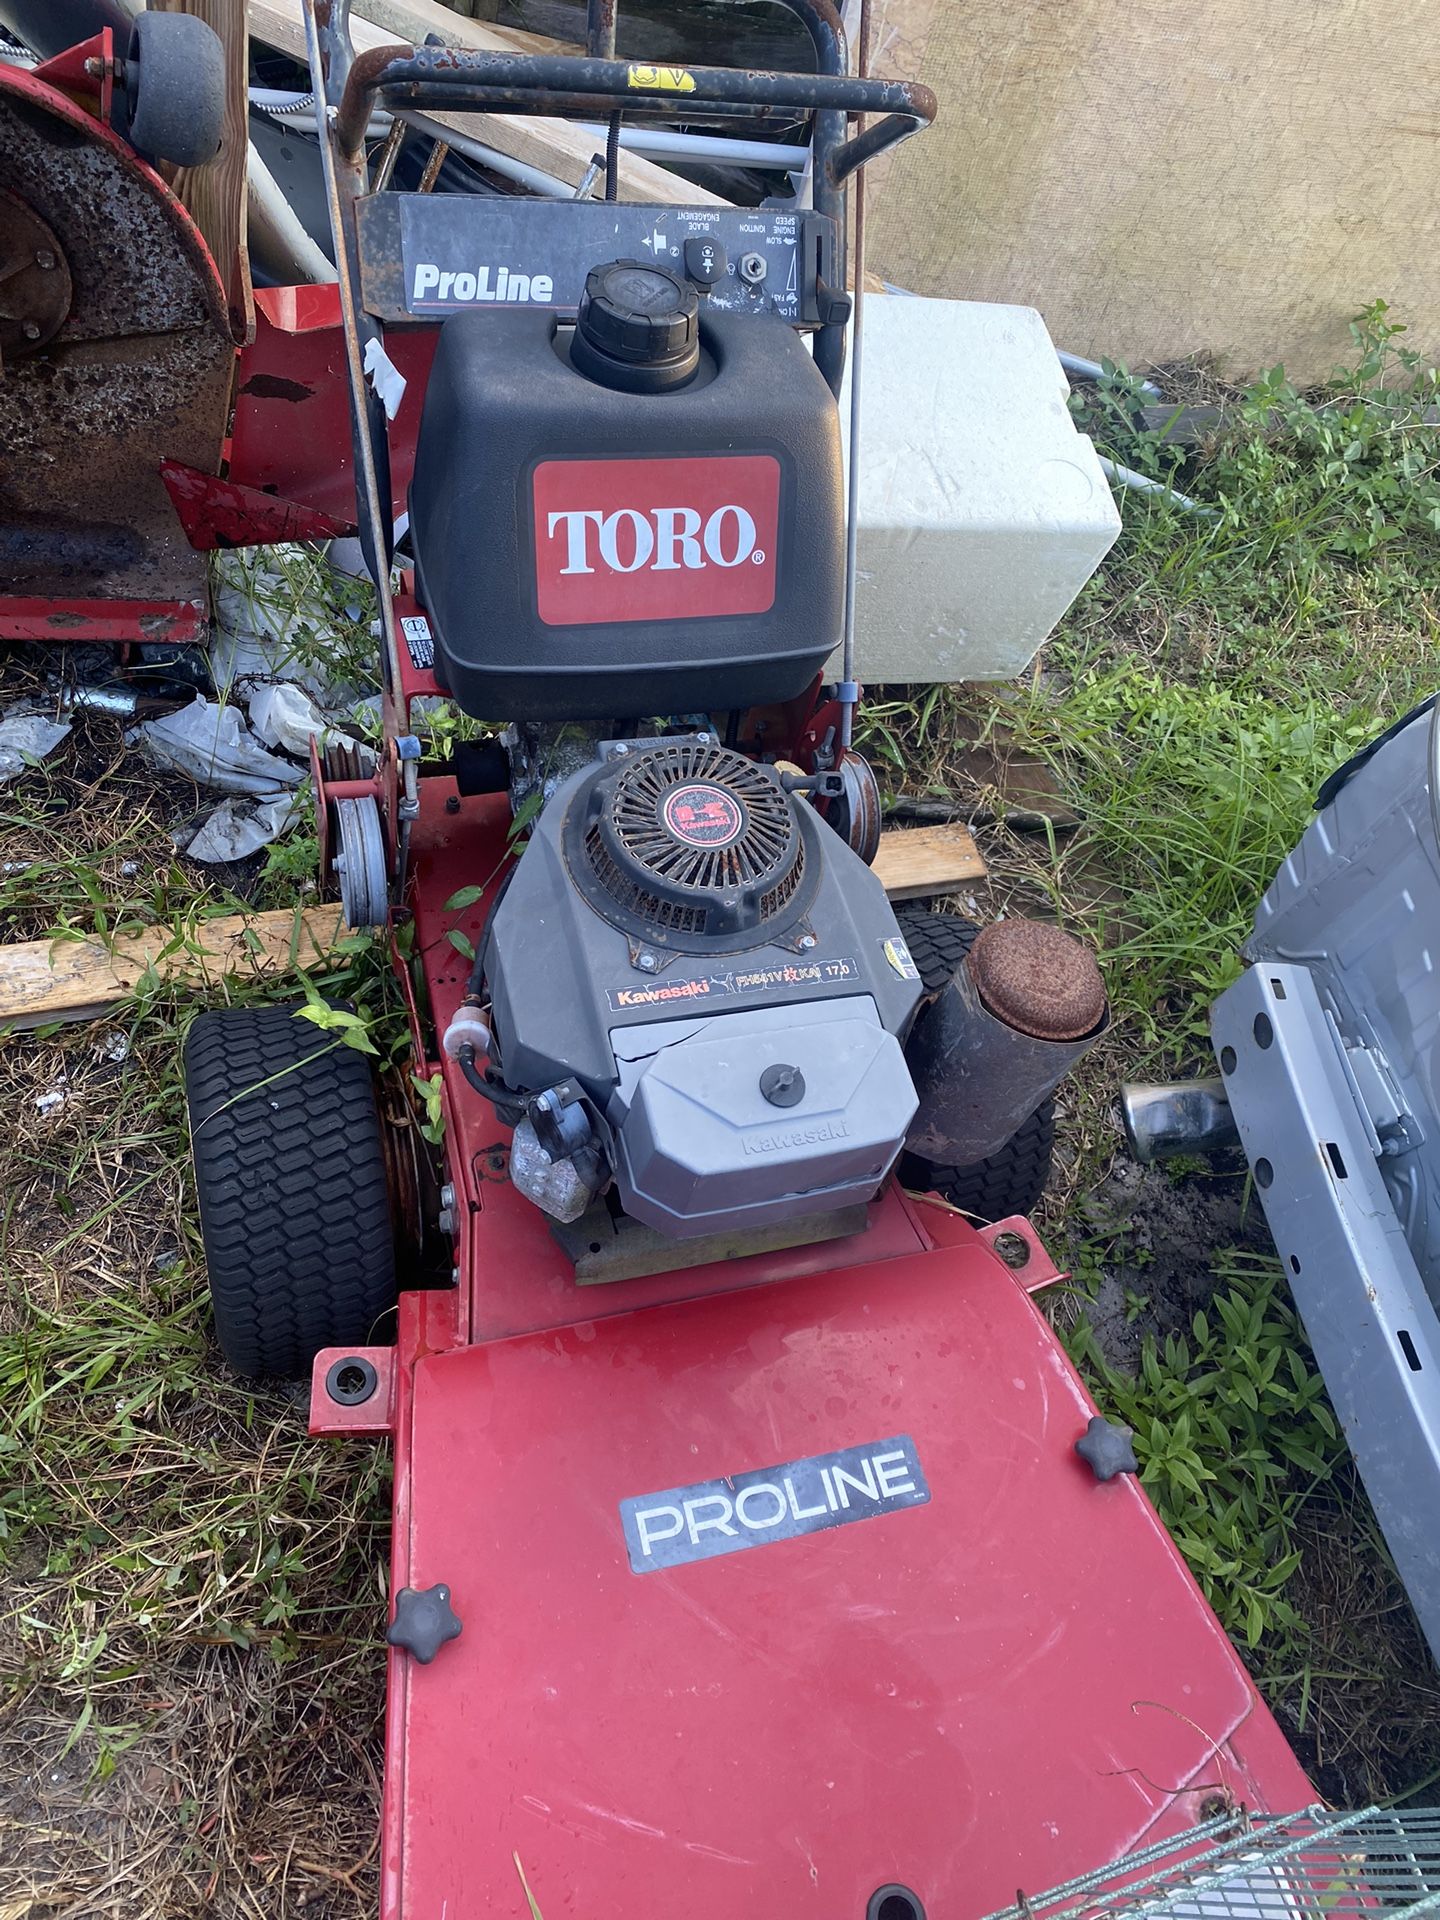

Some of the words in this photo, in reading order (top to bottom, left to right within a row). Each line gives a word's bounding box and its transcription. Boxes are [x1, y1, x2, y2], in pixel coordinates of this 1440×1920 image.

[677, 212, 720, 222] ENGAGEMENT
[775, 217, 796, 226] SPEED
[688, 222, 710, 231] BLADE
[739, 224, 766, 233] IGNITION
[773, 225, 796, 235] ENGINE
[765, 237, 782, 245] SLOW
[413, 263, 554, 302] ProLine
[617, 980, 710, 1006] Kawasaki
[741, 1119, 850, 1155] Kawasaki
[634, 1449, 916, 1556] PROLINE
